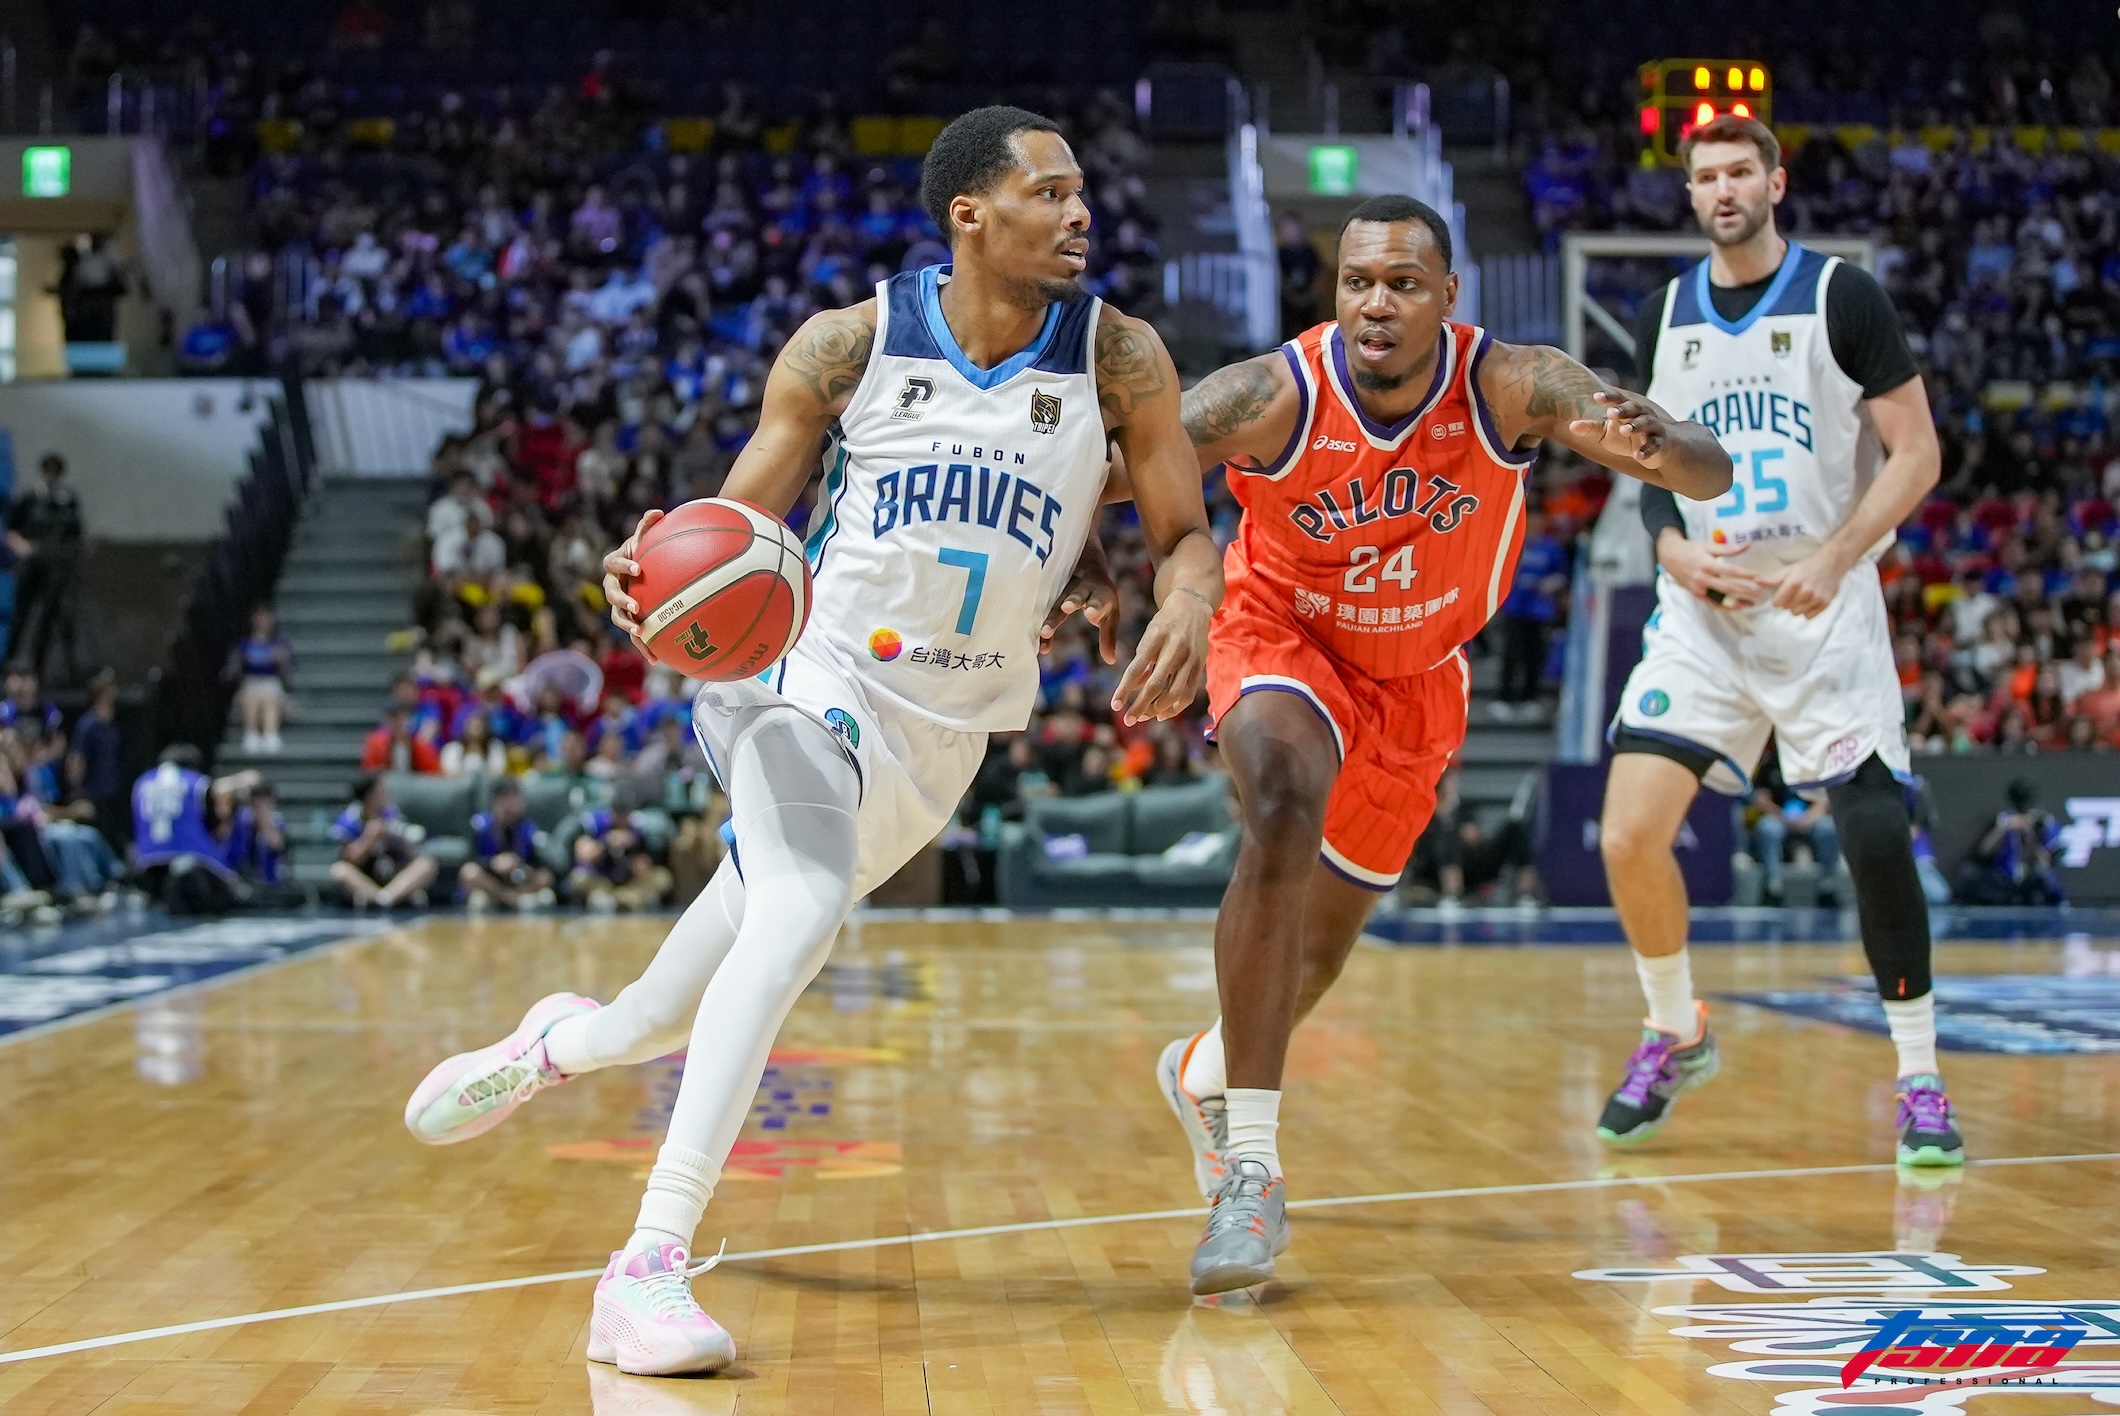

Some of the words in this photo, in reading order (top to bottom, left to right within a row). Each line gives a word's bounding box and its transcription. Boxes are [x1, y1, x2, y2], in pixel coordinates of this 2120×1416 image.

[893, 410, 923, 421] LEAGUE
[1033, 421, 1057, 434] TAIPEI
[1688, 391, 1814, 454] RAVES
[931, 441, 1026, 465] FUBON
[1326, 439, 1357, 452] asics
[873, 463, 1062, 569] BRAVES
[1288, 467, 1480, 544] PILOTS
[1343, 544, 1419, 593] 24
[937, 547, 989, 636] 7
[1371, 621, 1424, 633] ARCHILAND
[909, 646, 1006, 671] 台灣大哥大
